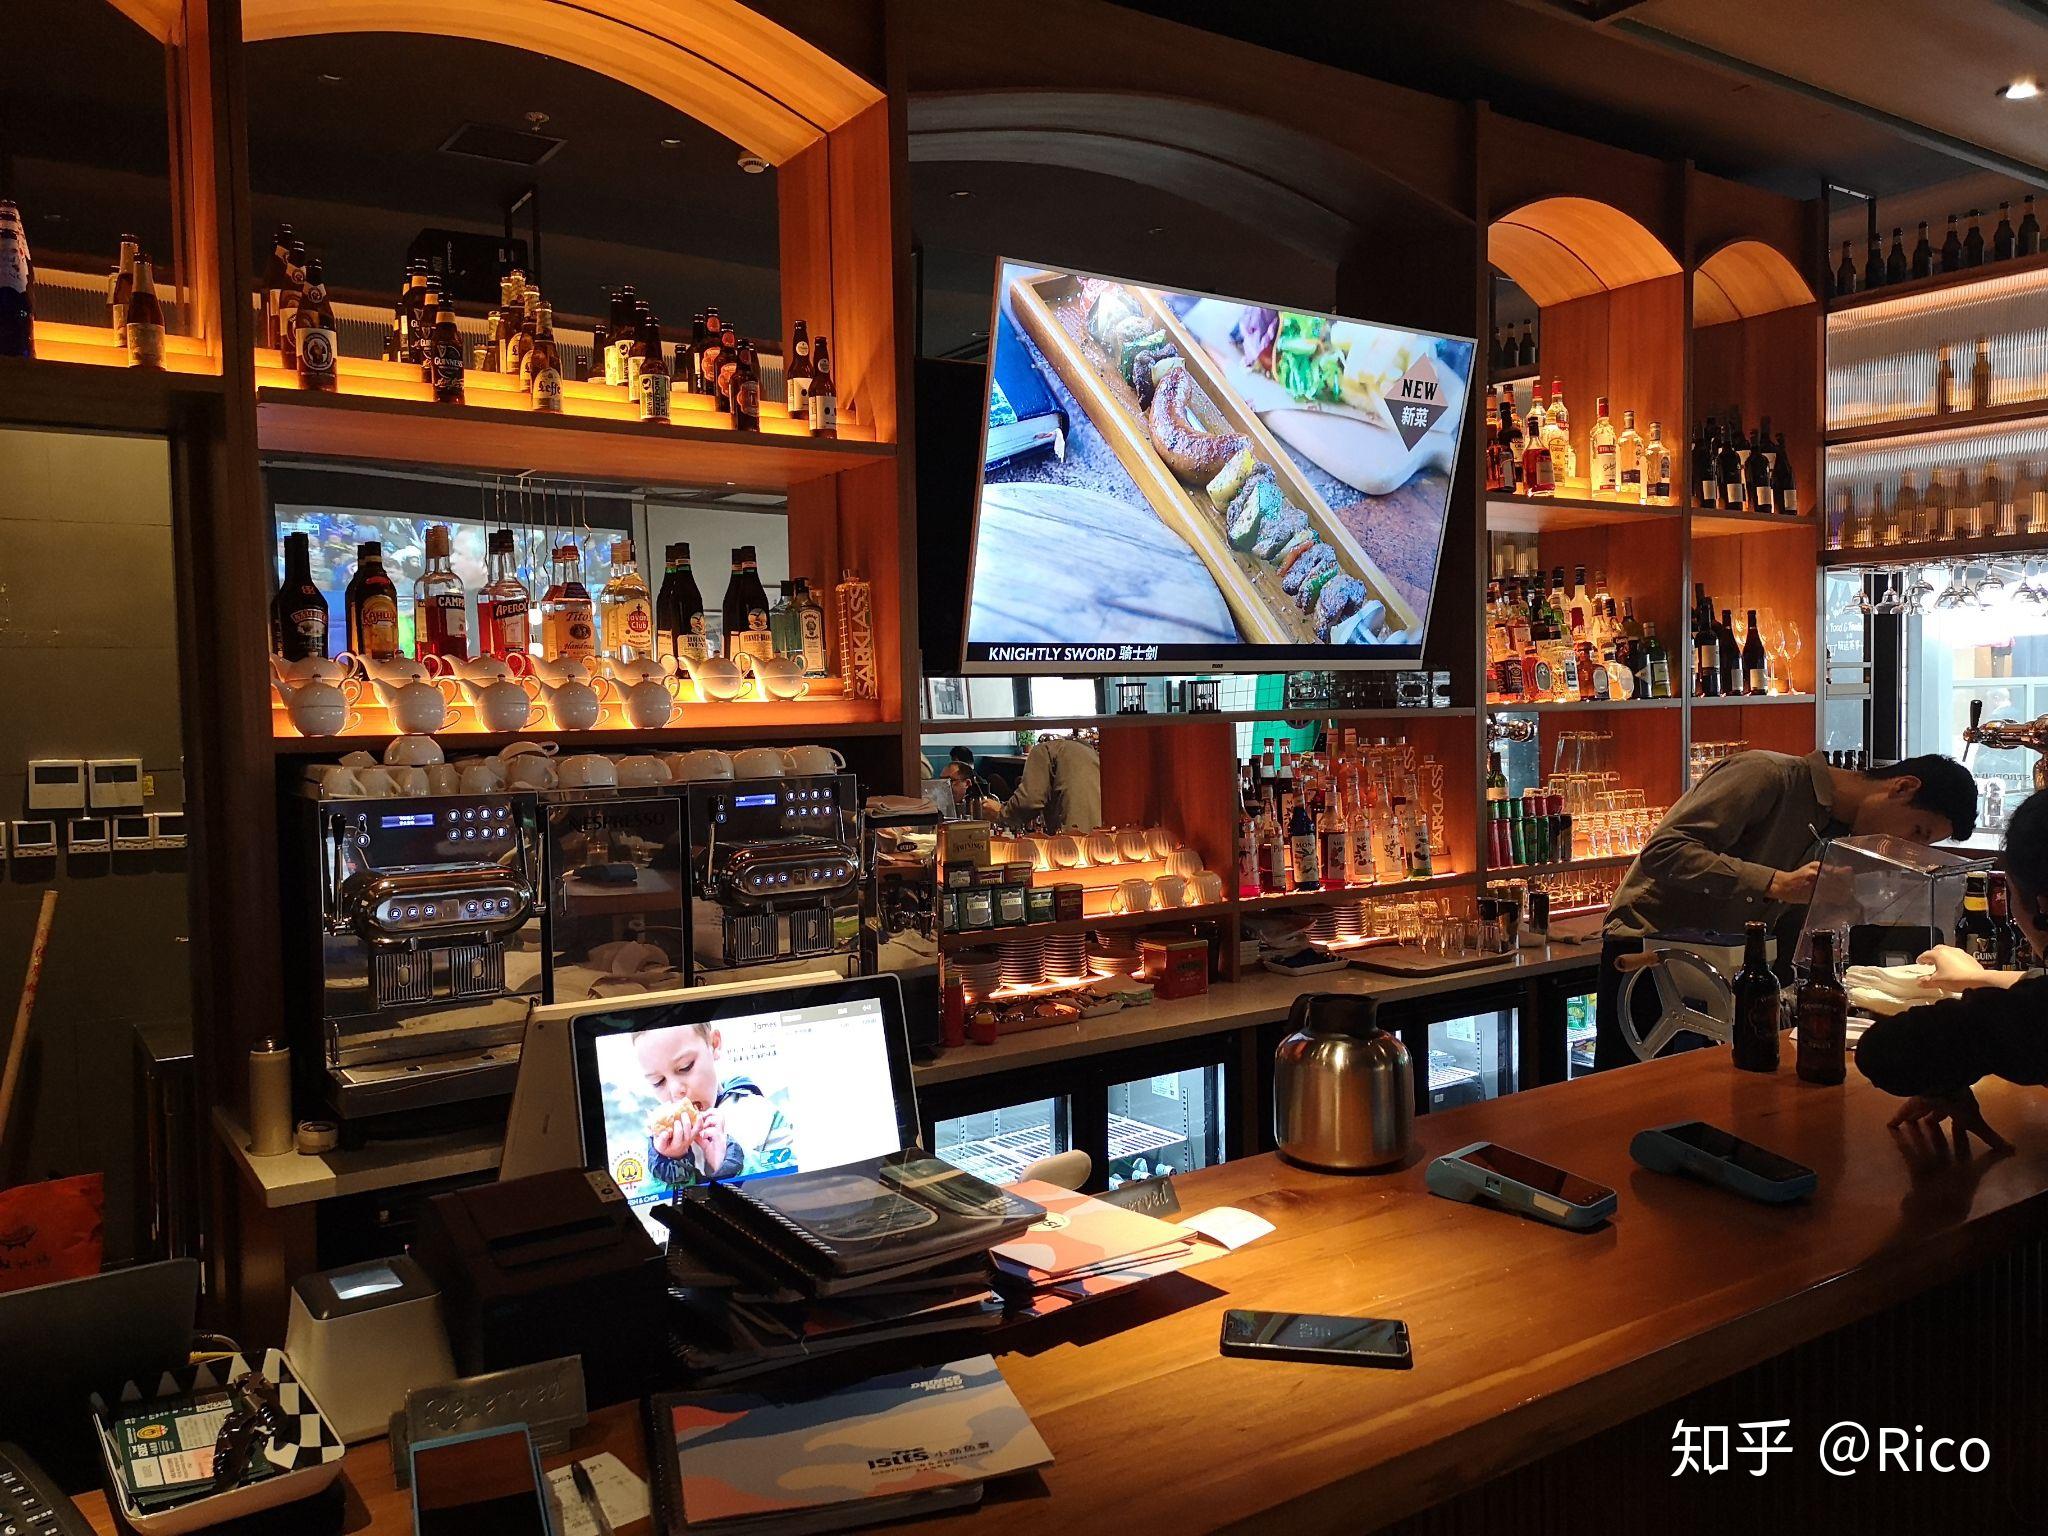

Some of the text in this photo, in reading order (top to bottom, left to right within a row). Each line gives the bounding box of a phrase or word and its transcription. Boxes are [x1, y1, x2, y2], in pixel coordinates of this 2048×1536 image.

[1401, 378, 1438, 401] NEW
[1401, 405, 1429, 428] 新菜
[495, 602, 528, 617] APEROL
[631, 620, 647, 630] Club
[988, 645, 1158, 662] KNIGHTLY SWORD 骑士剑
[867, 1453, 930, 1470] ISLES
[4, 1524, 17, 1535] 6
